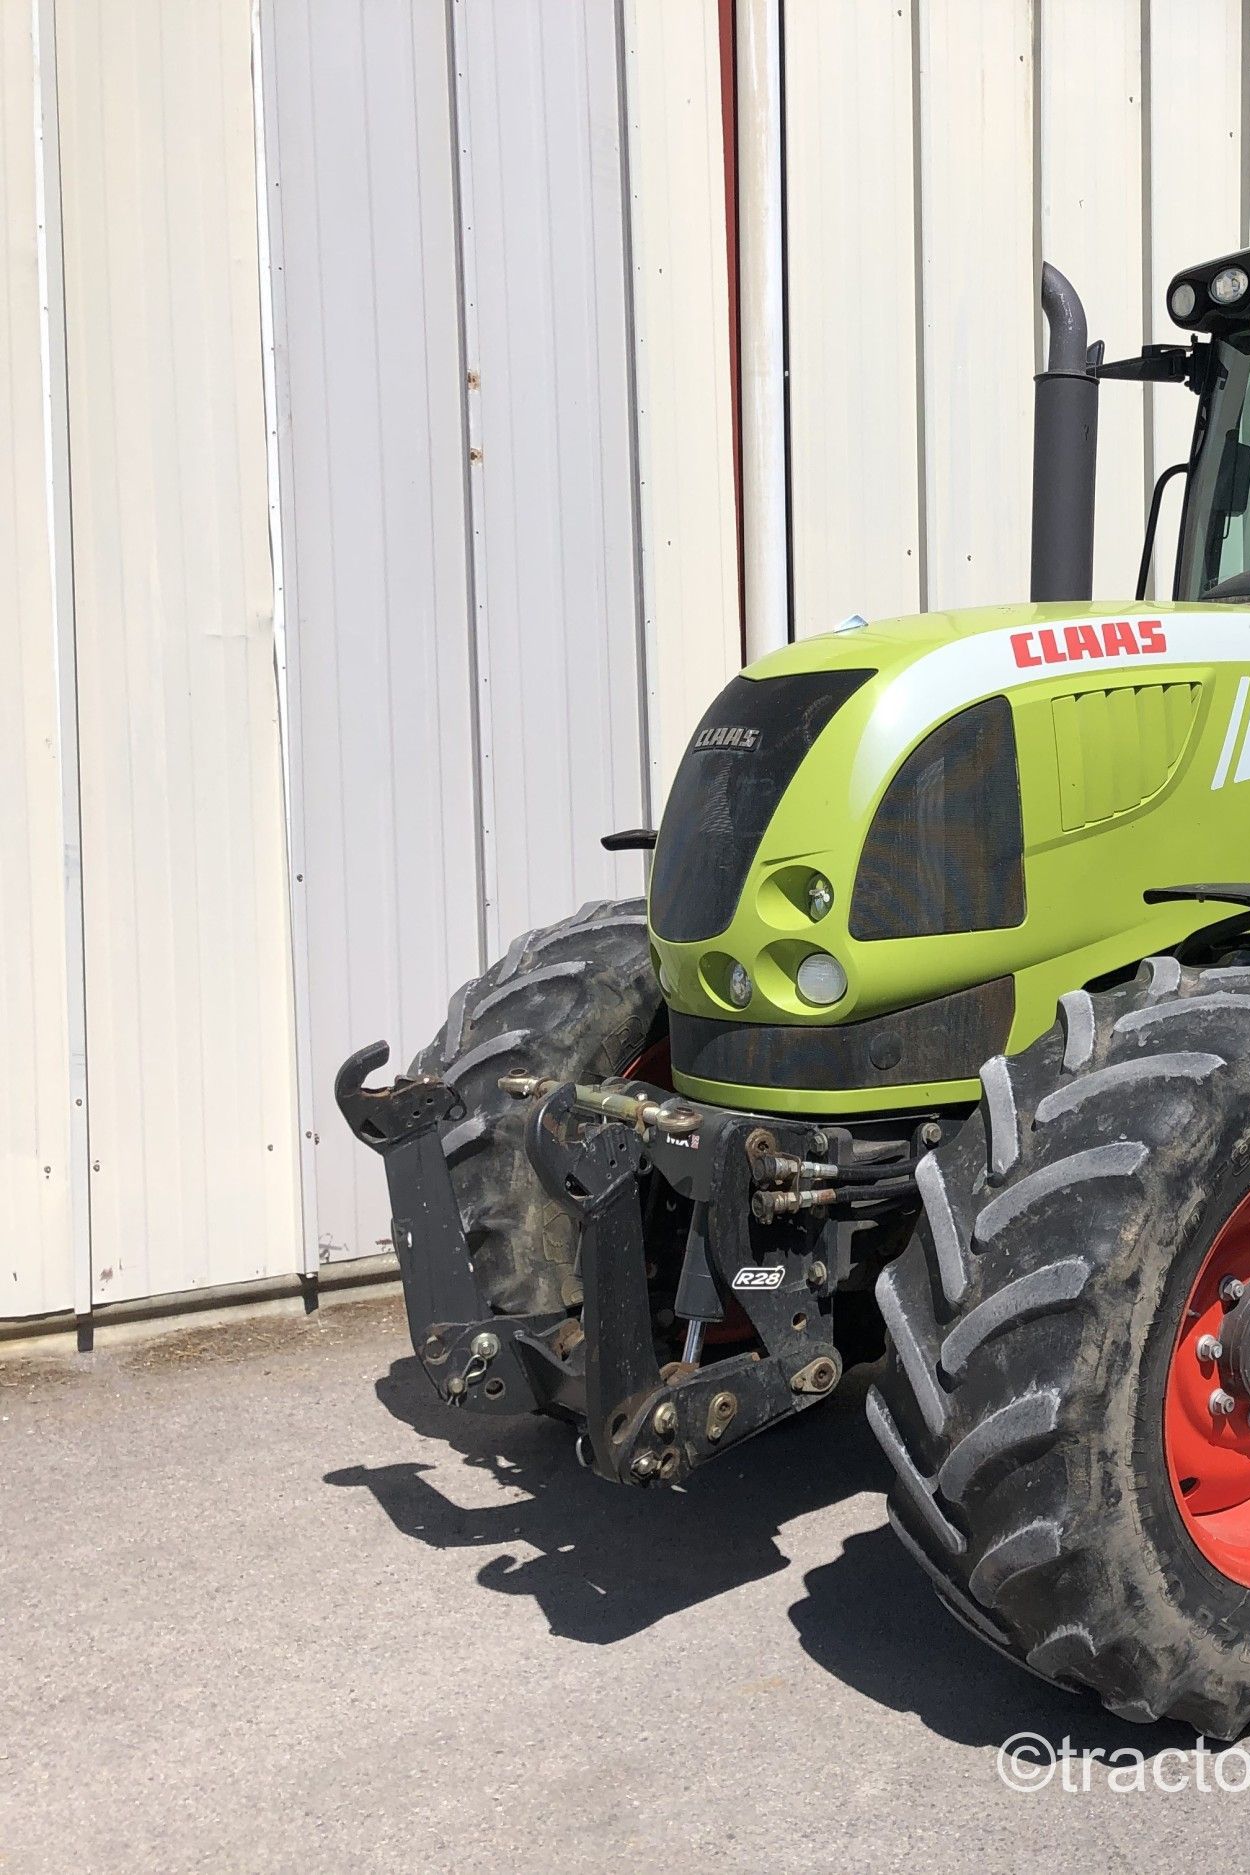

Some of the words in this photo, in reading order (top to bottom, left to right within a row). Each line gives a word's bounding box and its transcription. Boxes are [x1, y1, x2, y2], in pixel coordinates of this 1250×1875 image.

[1010, 620, 1167, 668] CLAAS
[694, 727, 760, 748] CLAAS
[735, 1270, 782, 1286] R28
